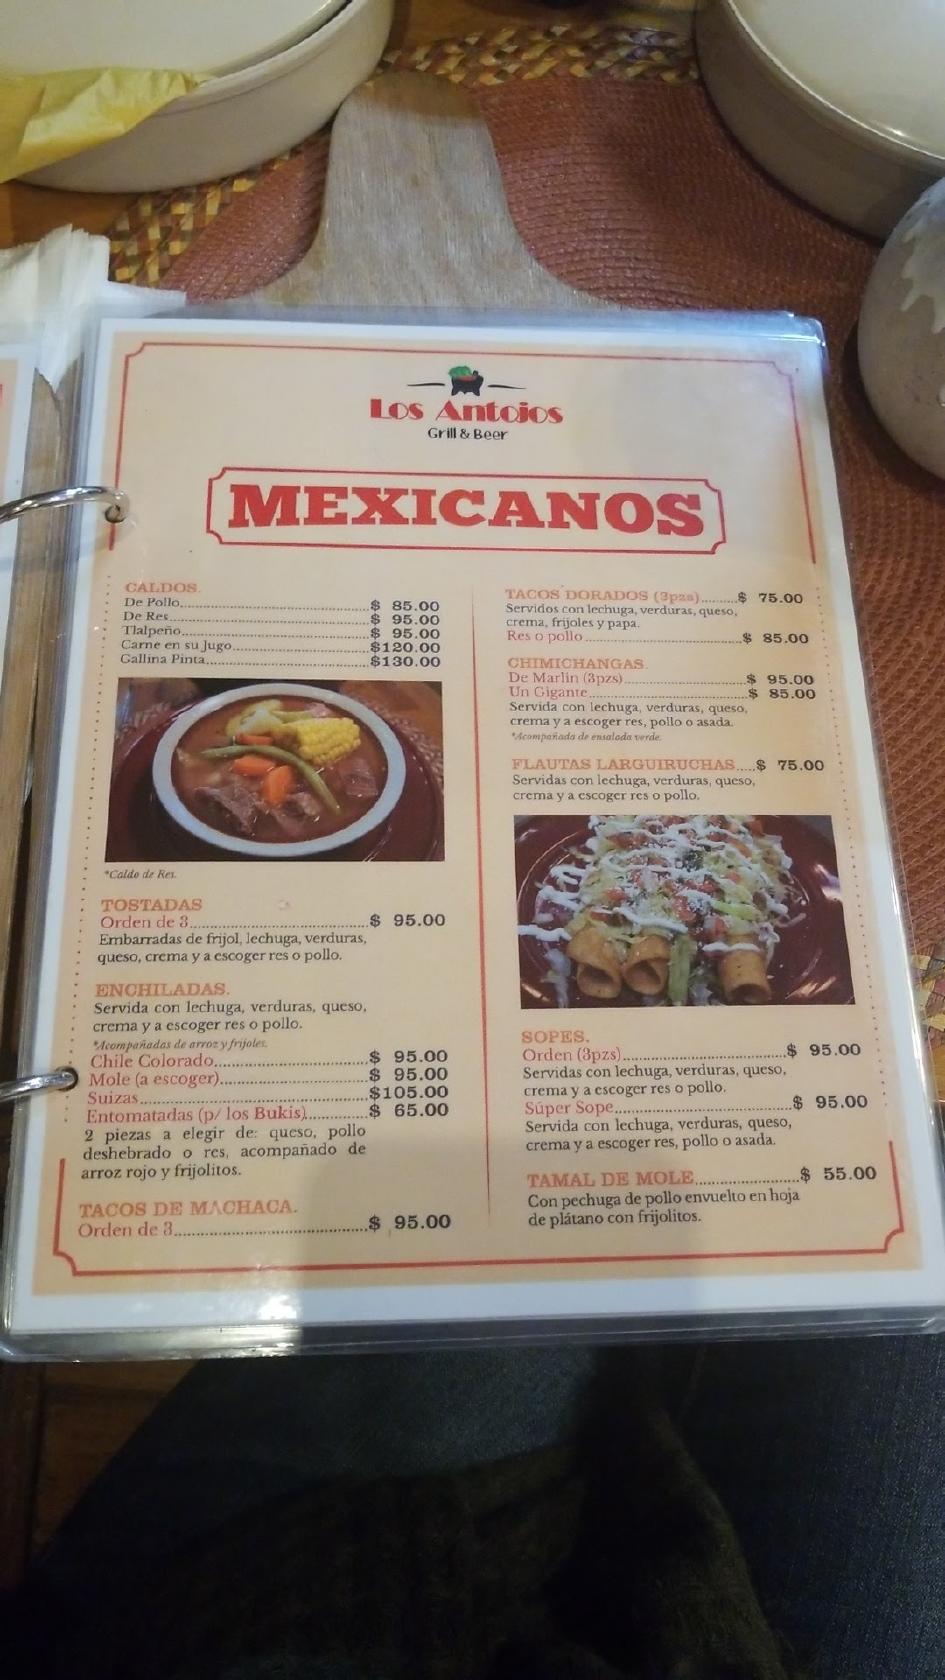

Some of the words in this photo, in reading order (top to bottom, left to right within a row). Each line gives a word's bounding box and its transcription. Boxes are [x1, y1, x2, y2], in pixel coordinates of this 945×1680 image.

[370, 398, 423, 421] Los
[435, 399, 564, 424] Antojos
[427, 427, 457, 440] Grill
[459, 428, 471, 440] &
[473, 428, 509, 441] Beer
[228, 484, 704, 537] MEXICANOS
[124, 597, 143, 607] De
[146, 597, 180, 608] Pollo
[392, 601, 440, 612] 85.00
[505, 589, 560, 600] TACOS
[566, 590, 649, 601] DORADOS
[653, 591, 700, 605] (3pzs)
[758, 593, 803, 604] 75.00
[123, 611, 142, 621] De
[146, 611, 169, 621] Res
[392, 615, 440, 626] 95.00
[506, 618, 549, 629] crema,
[552, 617, 594, 630] frijoles
[597, 620, 604, 630] y
[607, 620, 640, 630] papa.
[122, 625, 181, 638] Tlalpeño
[392, 628, 440, 639] 95.00
[507, 631, 531, 642] Res
[534, 633, 544, 642] o
[547, 631, 583, 645] pollo
[762, 633, 809, 644] 85.00
[121, 640, 160, 651] Carne
[164, 642, 181, 650] en
[185, 642, 199, 651] su
[202, 641, 232, 653] Jugo
[370, 642, 440, 654] $120.00
[120, 654, 168, 664] Gallina
[171, 654, 205, 665] Pinta
[370, 656, 441, 668] $130.00
[508, 672, 530, 684] De
[582, 672, 623, 687] (3pzs)
[767, 675, 815, 686] 95.00
[509, 686, 531, 698] Un
[534, 686, 588, 700] Gigante
[769, 688, 816, 699] 85.00
[578, 732, 589, 741] de
[591, 732, 632, 742] ensalada
[511, 758, 592, 771] FLAUTAS
[596, 759, 735, 771] LARGUIRUCHAS
[777, 760, 824, 771] 75.00
[142, 869, 154, 879] de
[100, 916, 151, 929] Orden
[156, 916, 175, 928] de
[393, 914, 446, 927] 95.00
[99, 933, 182, 946] Embarradas
[185, 933, 203, 945] de
[206, 932, 242, 947] frijol,
[245, 932, 301, 946] lechuga,
[305, 932, 367, 946] verduras,
[94, 983, 231, 998] ENCHILADAS.
[94, 1002, 148, 1016] Servida
[154, 1003, 181, 1014] con
[186, 1001, 245, 1015] lechuga,
[251, 1001, 316, 1014] verduras,
[321, 1002, 367, 1014] queso,
[174, 1039, 186, 1049] de
[189, 1038, 218, 1050] arroz
[221, 1040, 228, 1050] y
[521, 1030, 590, 1044] SOPES.
[91, 1054, 134, 1069] Chile
[137, 1054, 214, 1068] Colorado
[394, 1050, 448, 1063] 95.00
[523, 1048, 573, 1062] Orden
[577, 1047, 622, 1064] (3pzs)
[809, 1044, 861, 1056] 95.00
[89, 1072, 131, 1087] Mole
[135, 1072, 150, 1087] (a
[153, 1071, 220, 1088] escoger)
[394, 1068, 448, 1081] 95.00
[87, 1091, 138, 1105] Suizas
[369, 1086, 449, 1100] $105.00
[86, 1107, 194, 1124] Entomatadas
[226, 1106, 250, 1121] los
[394, 1103, 449, 1117] 65.00
[524, 1101, 571, 1116] Súper
[576, 1101, 614, 1116] Sope
[815, 1096, 868, 1109] 95.00
[84, 1129, 94, 1142] 2
[105, 1128, 151, 1144] piezas
[163, 1131, 171, 1140] a
[183, 1126, 225, 1143] elegir
[269, 1127, 317, 1142] queso,
[328, 1125, 366, 1141] pollo
[83, 1146, 171, 1161] deshebrado
[183, 1150, 193, 1159] o
[240, 1144, 337, 1160] acompañado
[348, 1142, 366, 1155] de
[81, 1167, 121, 1179] arroz
[126, 1165, 157, 1181] rojo
[161, 1168, 171, 1181] y
[174, 1163, 242, 1179] frijolitos.
[527, 1173, 596, 1188] TAMAL
[601, 1173, 630, 1186] DE
[636, 1171, 694, 1185] MOLE
[823, 1166, 877, 1181] 55.00
[528, 1195, 558, 1209] Con
[561, 1193, 621, 1210] pechuga
[624, 1193, 642, 1206] de
[645, 1192, 682, 1207] pollo
[685, 1190, 746, 1204] envuelto
[749, 1192, 767, 1202] en
[770, 1189, 799, 1204] hoja
[79, 1203, 146, 1218] TACOS
[153, 1202, 183, 1216] DE
[78, 1223, 132, 1238] Orden
[137, 1223, 158, 1236] de
[394, 1215, 451, 1230] 95.00
[528, 1214, 546, 1227] de
[550, 1212, 604, 1229] plátano
[607, 1214, 634, 1224] con
[638, 1211, 701, 1227] frijolitos.
